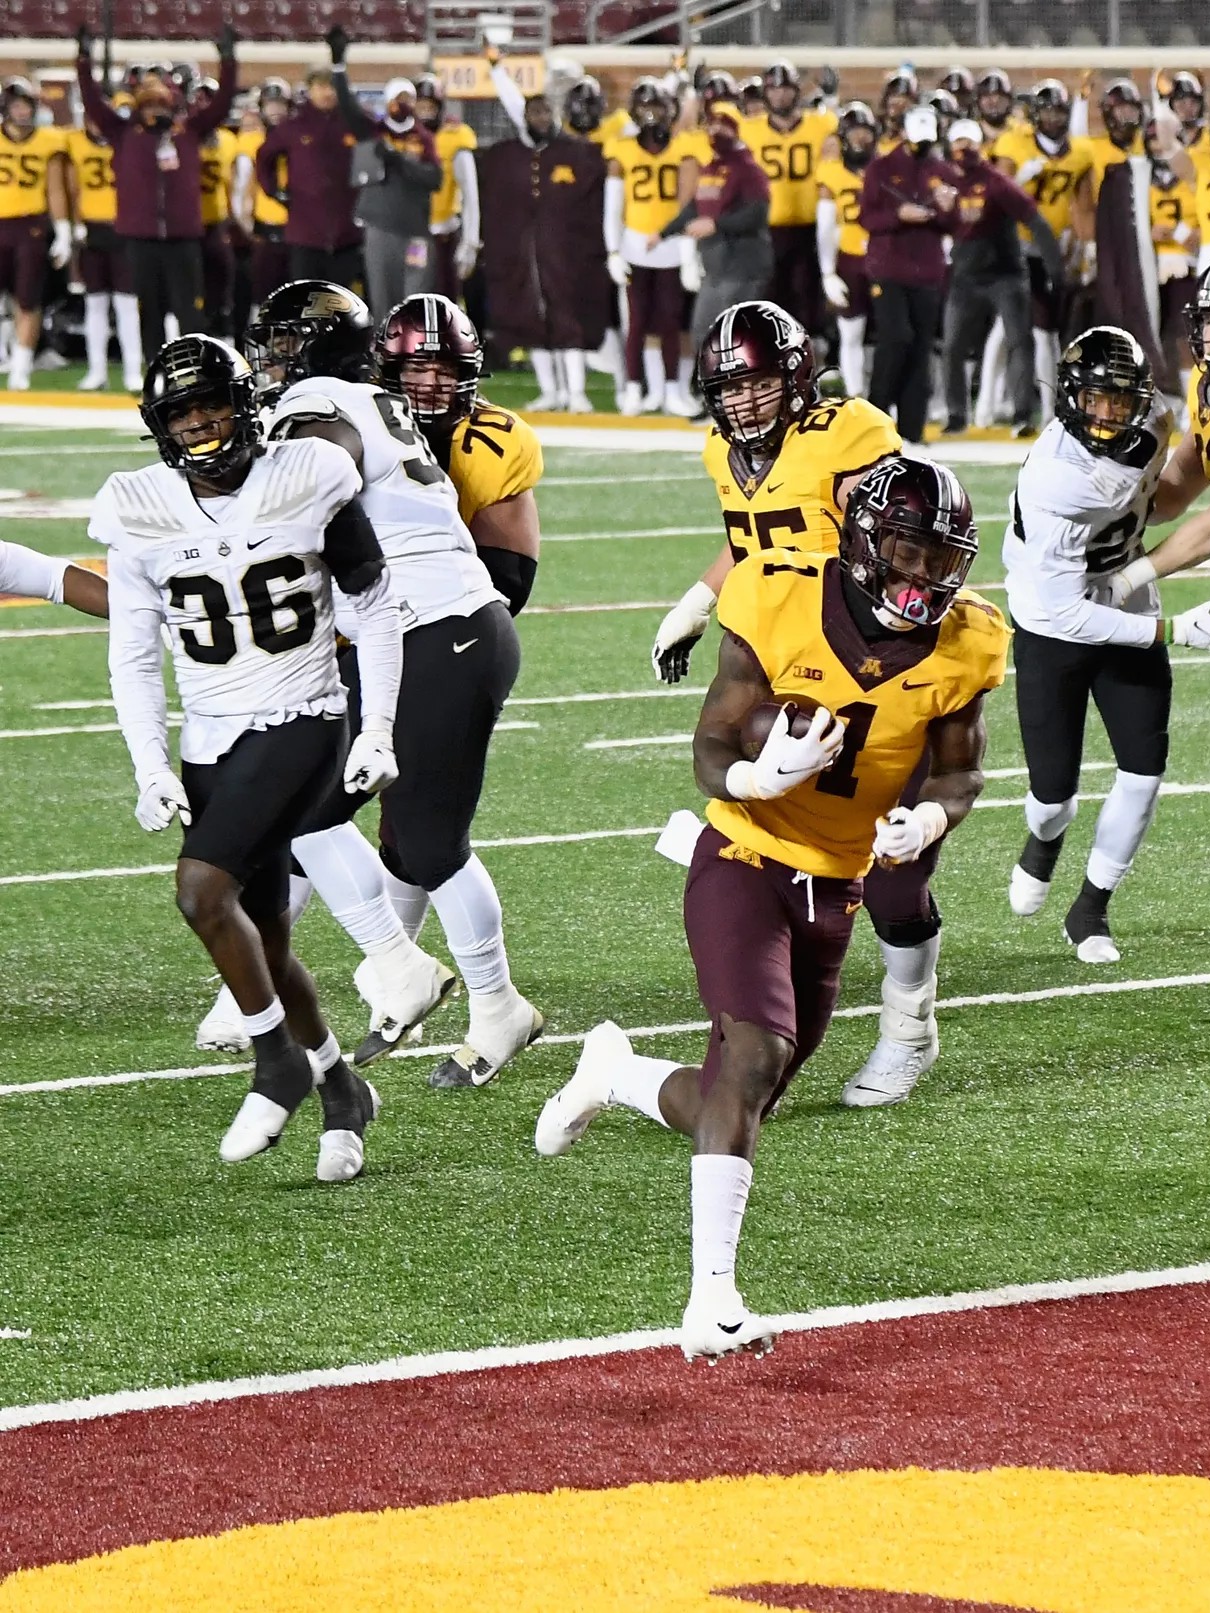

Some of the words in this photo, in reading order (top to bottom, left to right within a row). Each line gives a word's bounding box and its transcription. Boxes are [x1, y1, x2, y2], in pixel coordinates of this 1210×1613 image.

[631, 164, 681, 202] 20
[761, 143, 812, 181] 50
[170, 554, 316, 665] 36
[814, 700, 879, 799] 1
